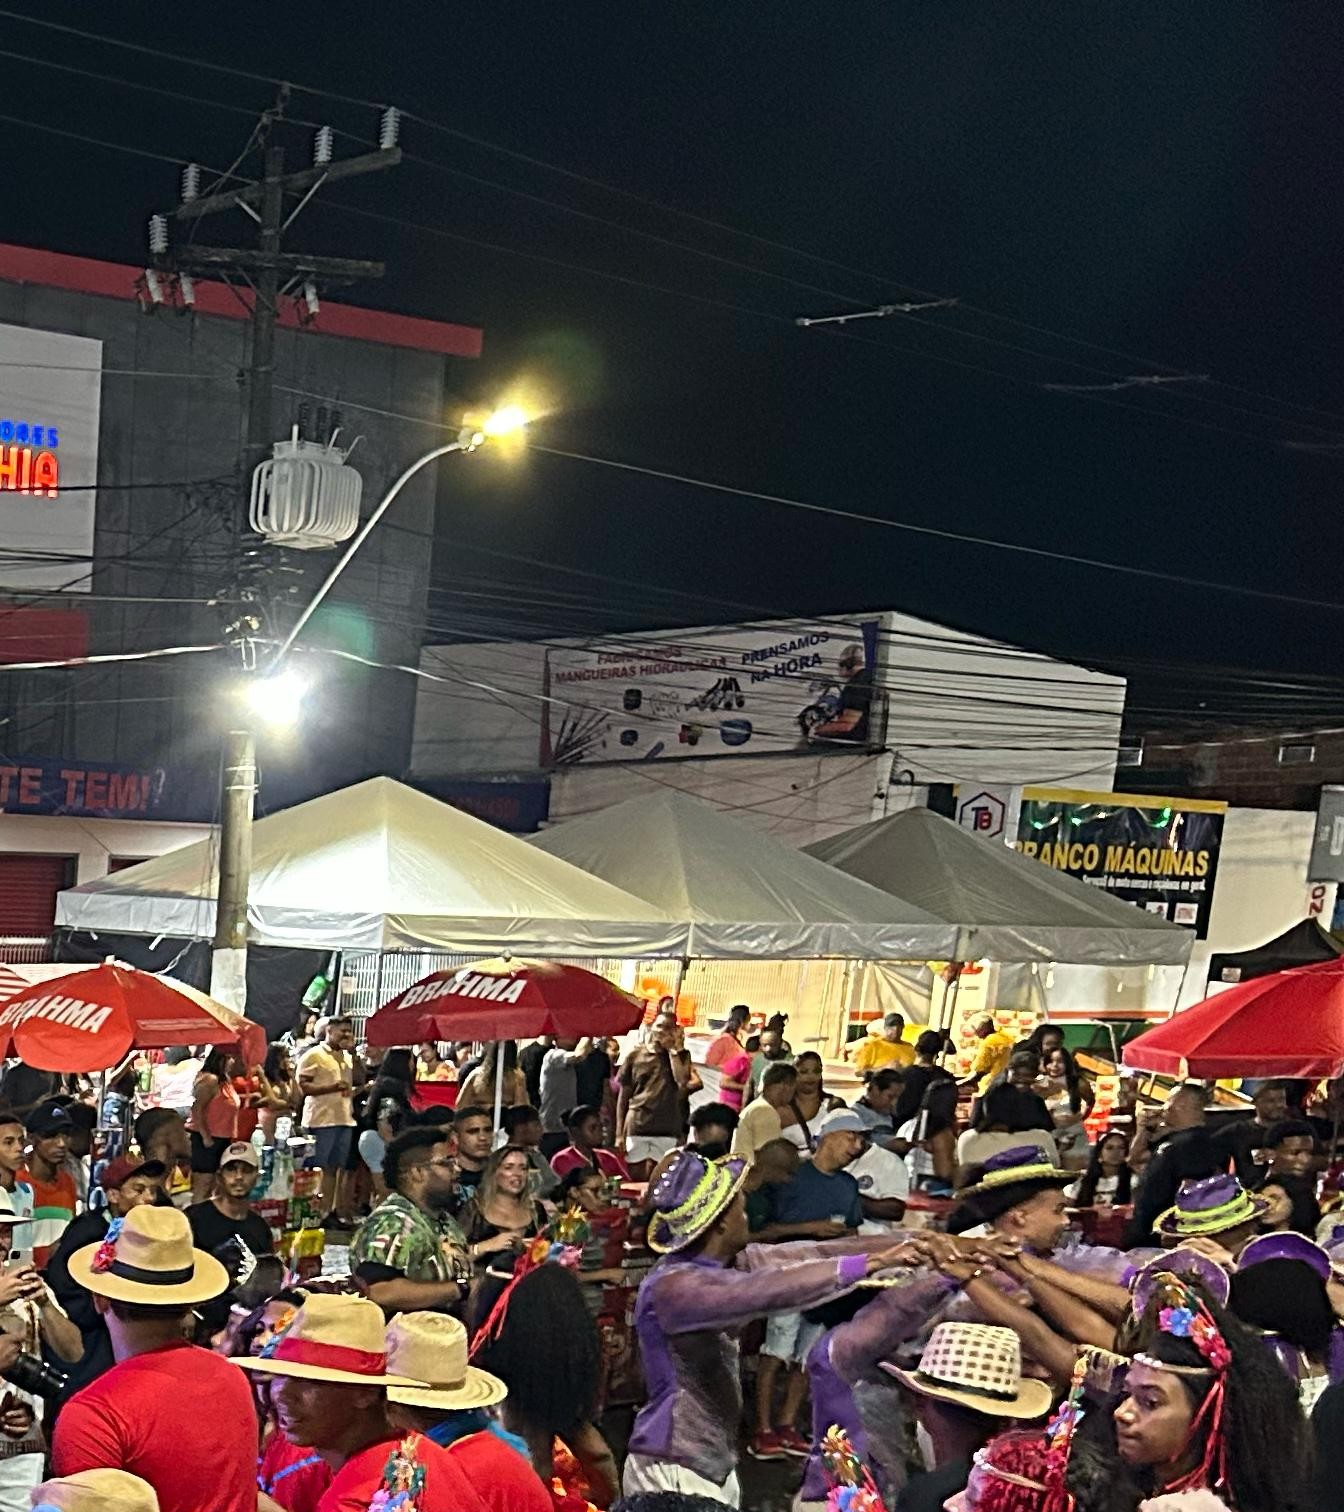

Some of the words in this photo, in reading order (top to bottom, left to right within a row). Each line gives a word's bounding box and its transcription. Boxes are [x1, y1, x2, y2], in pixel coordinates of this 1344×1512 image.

[741, 631, 830, 665] PRENSAMOS
[773, 652, 823, 678] HORA
[555, 665, 636, 683] MANGUEIRAS
[61, 768, 151, 812] TEM!
[1103, 841, 1210, 877] MÁQUINAS
[397, 973, 528, 1011] BRAHMA
